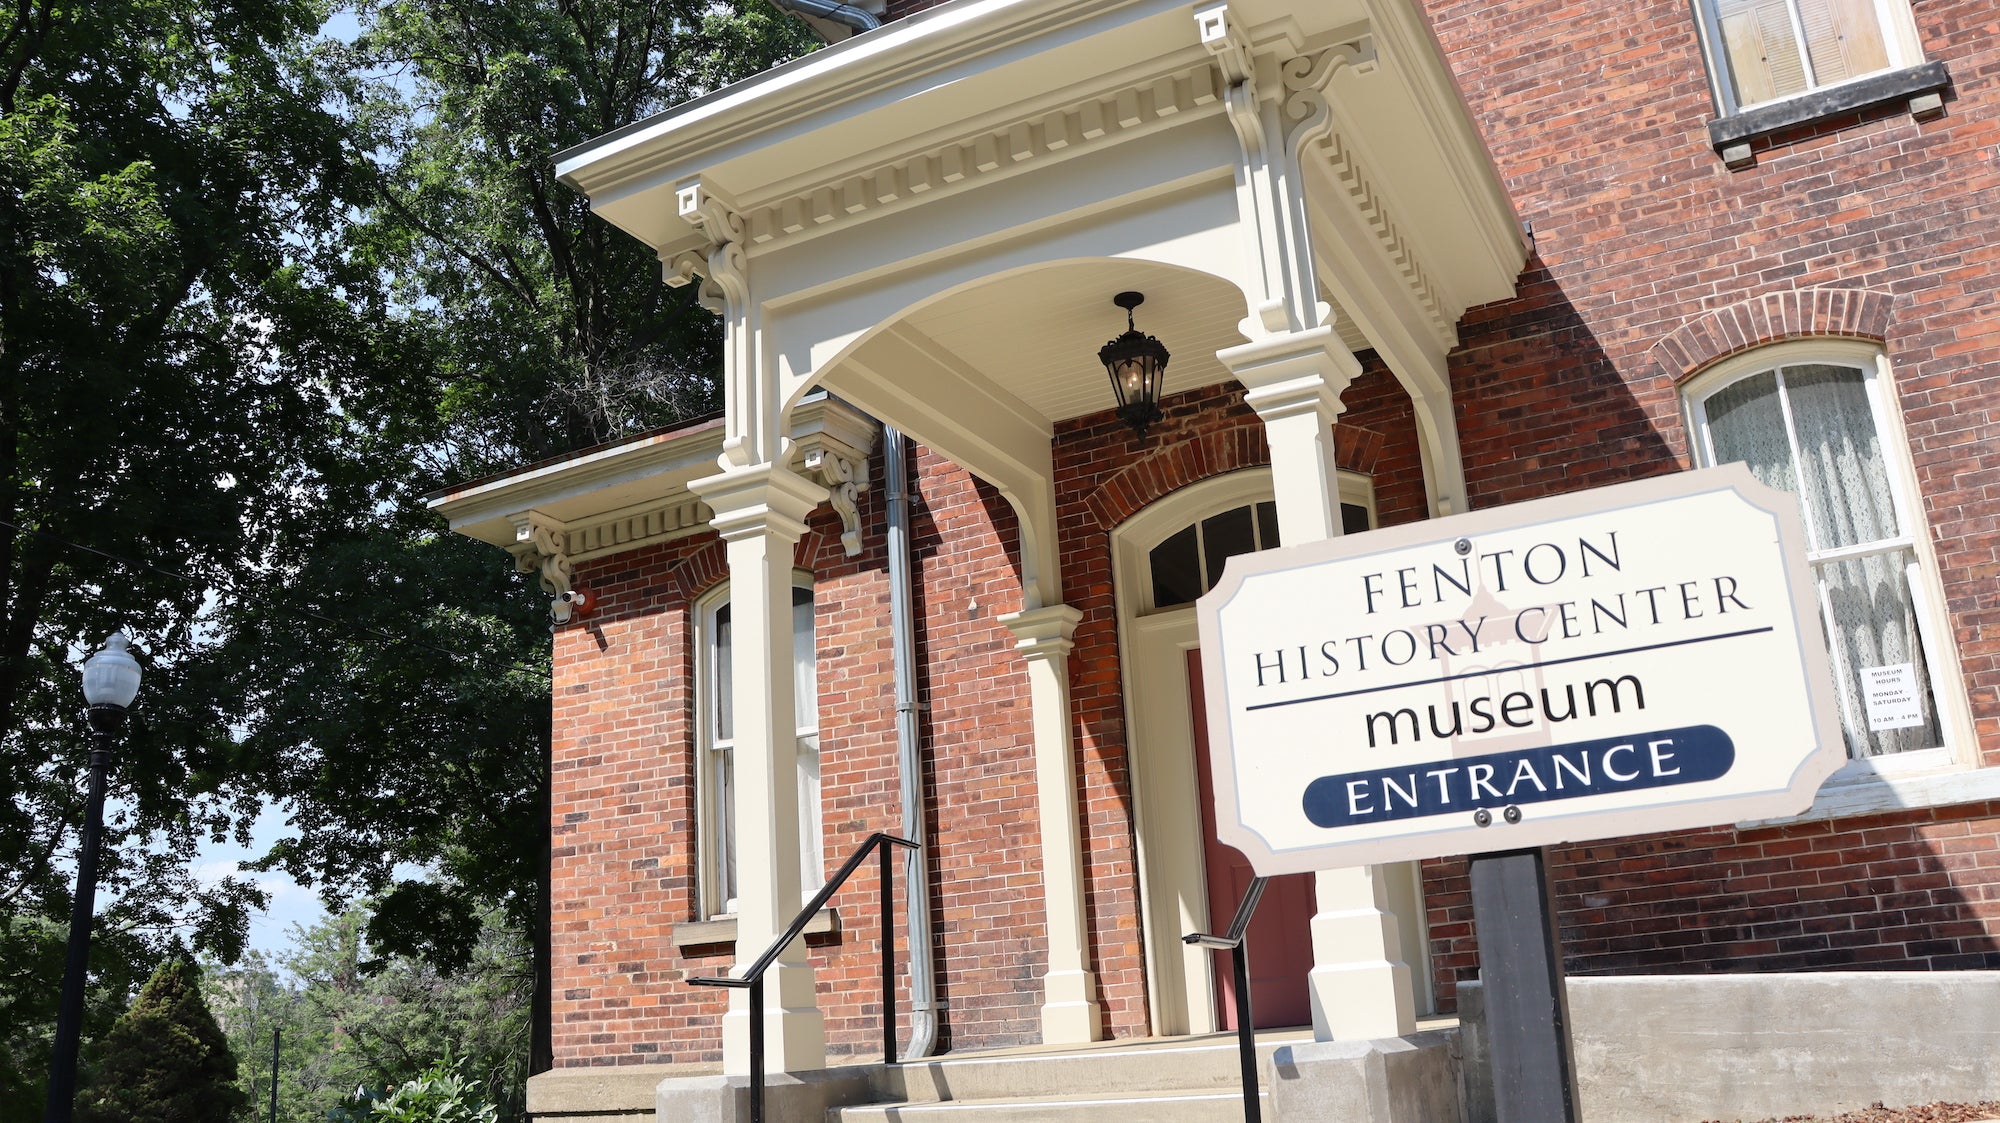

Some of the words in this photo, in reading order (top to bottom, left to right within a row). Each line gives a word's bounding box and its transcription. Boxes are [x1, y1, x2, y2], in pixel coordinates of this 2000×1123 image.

[1361, 531, 1623, 615] FENTON
[1253, 615, 1488, 688] HISTORY
[1514, 575, 1754, 645] CENTER
[1365, 673, 1646, 748] museum
[1871, 669, 1903, 677] MUSEUM
[1873, 690, 1903, 698] MONDAY
[1873, 697, 1911, 706] SATURDAY
[1345, 738, 1682, 817] ENTRANCE
